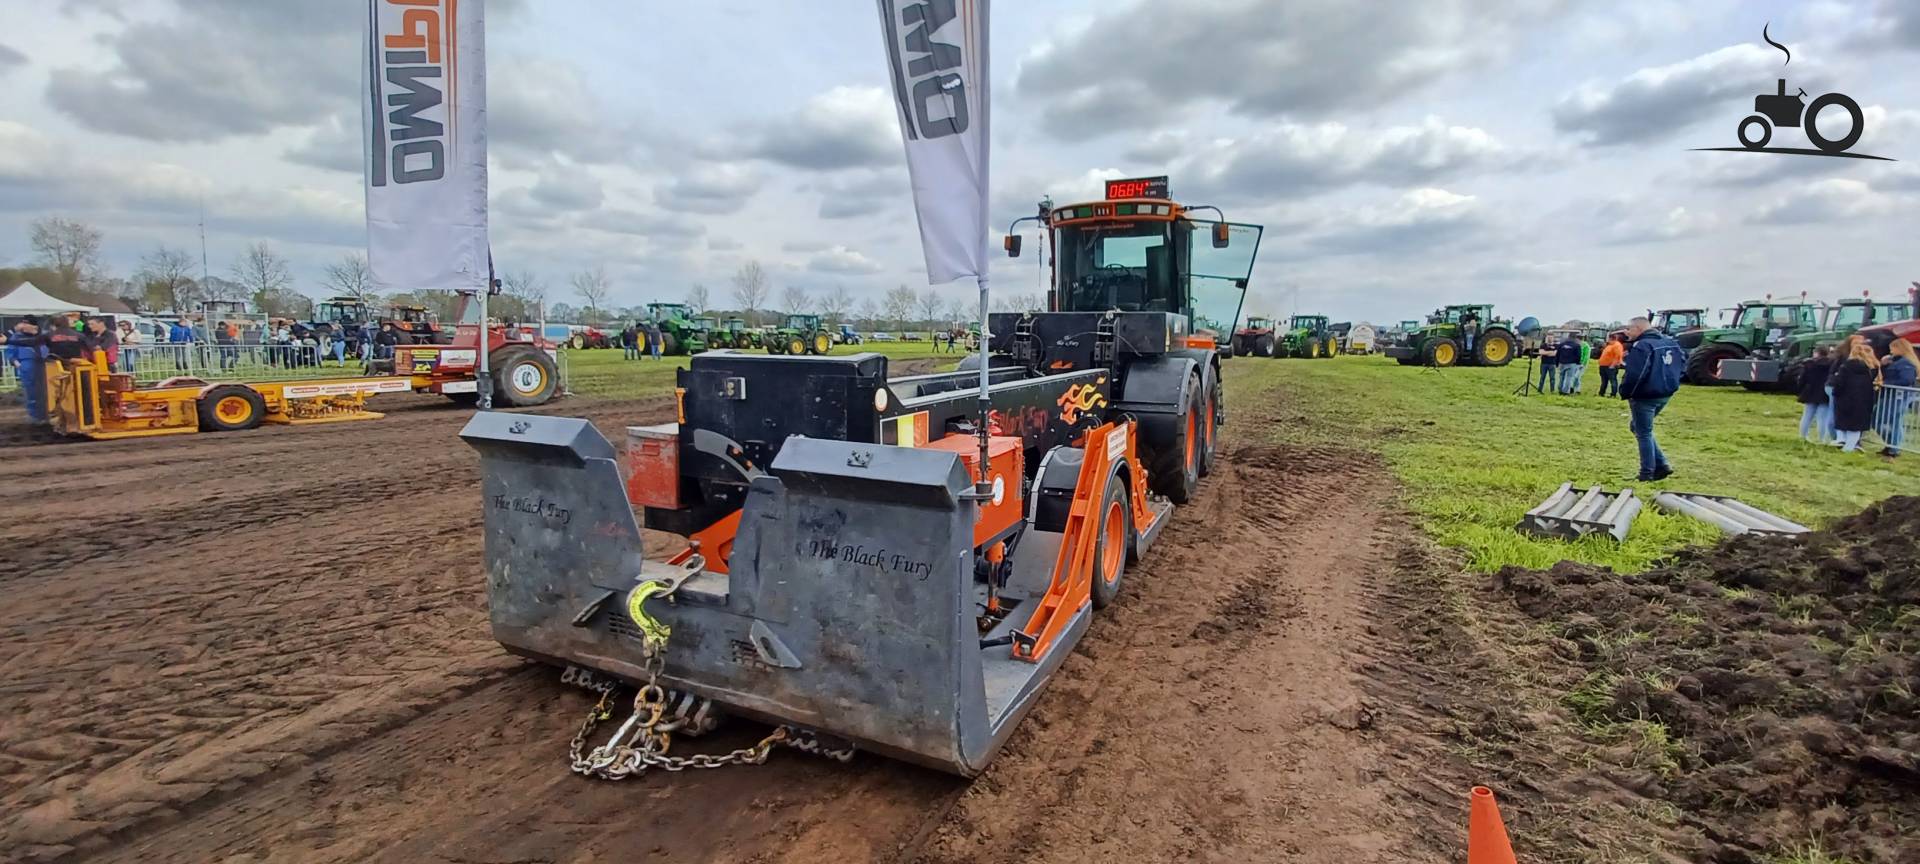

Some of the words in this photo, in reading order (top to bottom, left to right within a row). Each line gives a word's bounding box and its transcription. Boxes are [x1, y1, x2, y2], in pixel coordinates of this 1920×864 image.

[493, 495, 510, 510] The
[512, 498, 545, 519] Black
[547, 503, 571, 525] Fury
[809, 540, 839, 559] The
[841, 545, 888, 573] Black
[891, 554, 932, 581] Fury
